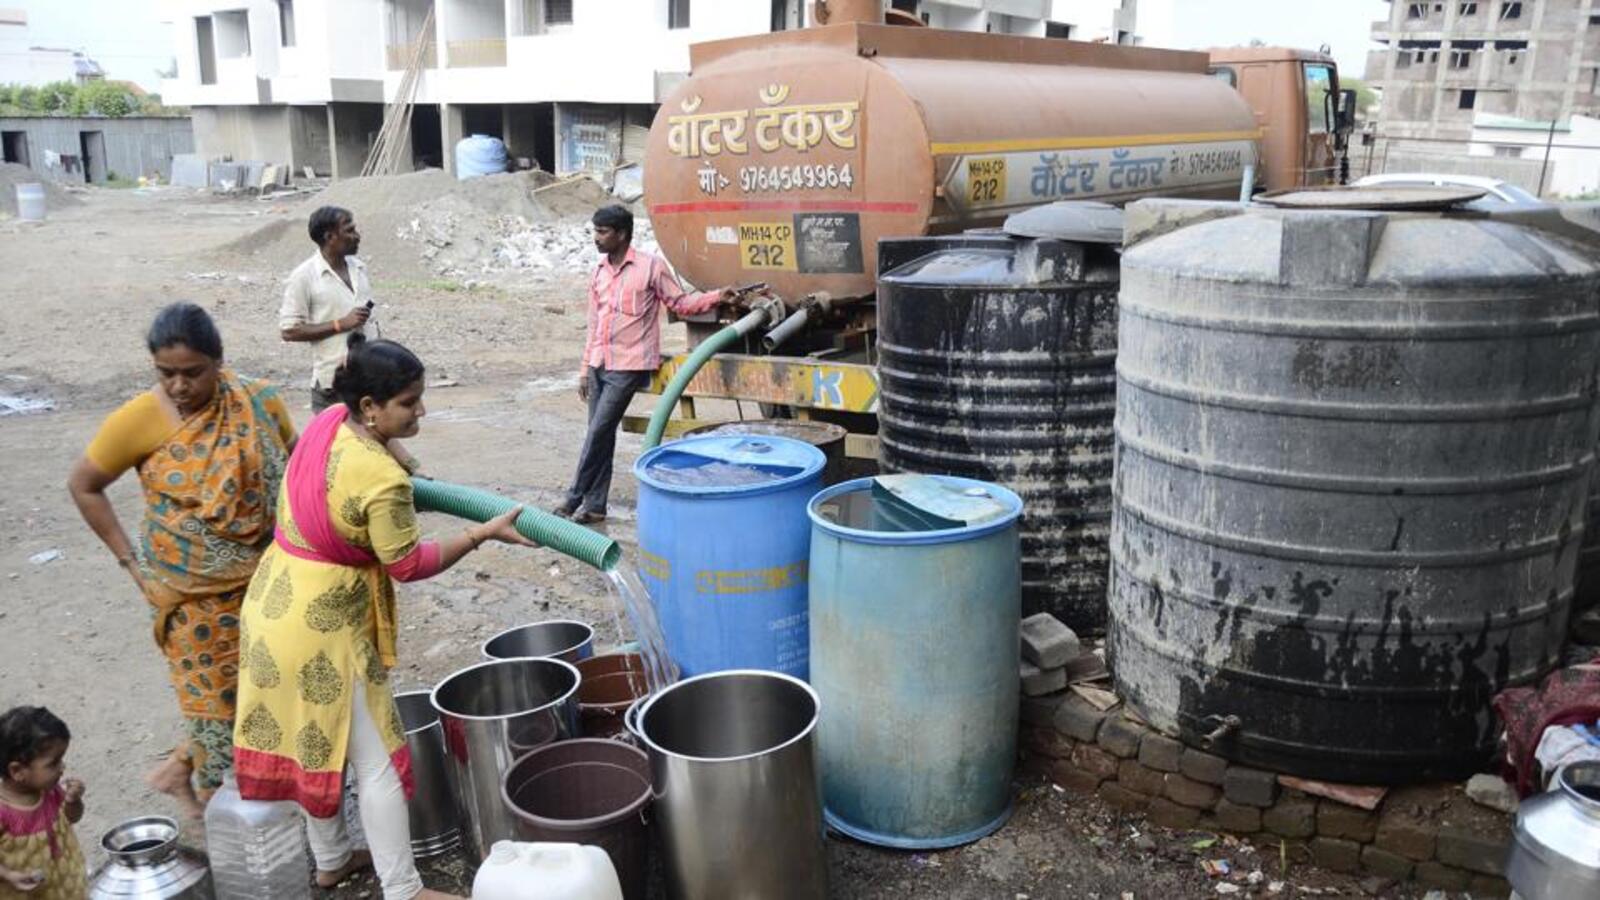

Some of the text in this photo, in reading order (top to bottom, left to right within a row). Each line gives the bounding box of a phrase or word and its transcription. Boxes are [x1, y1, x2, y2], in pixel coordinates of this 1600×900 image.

[669, 94, 748, 157] वॉटर
[739, 163, 852, 192] 9764549964
[973, 178, 998, 201] 212
[775, 226, 791, 241] CP
[748, 244, 784, 266] 212
